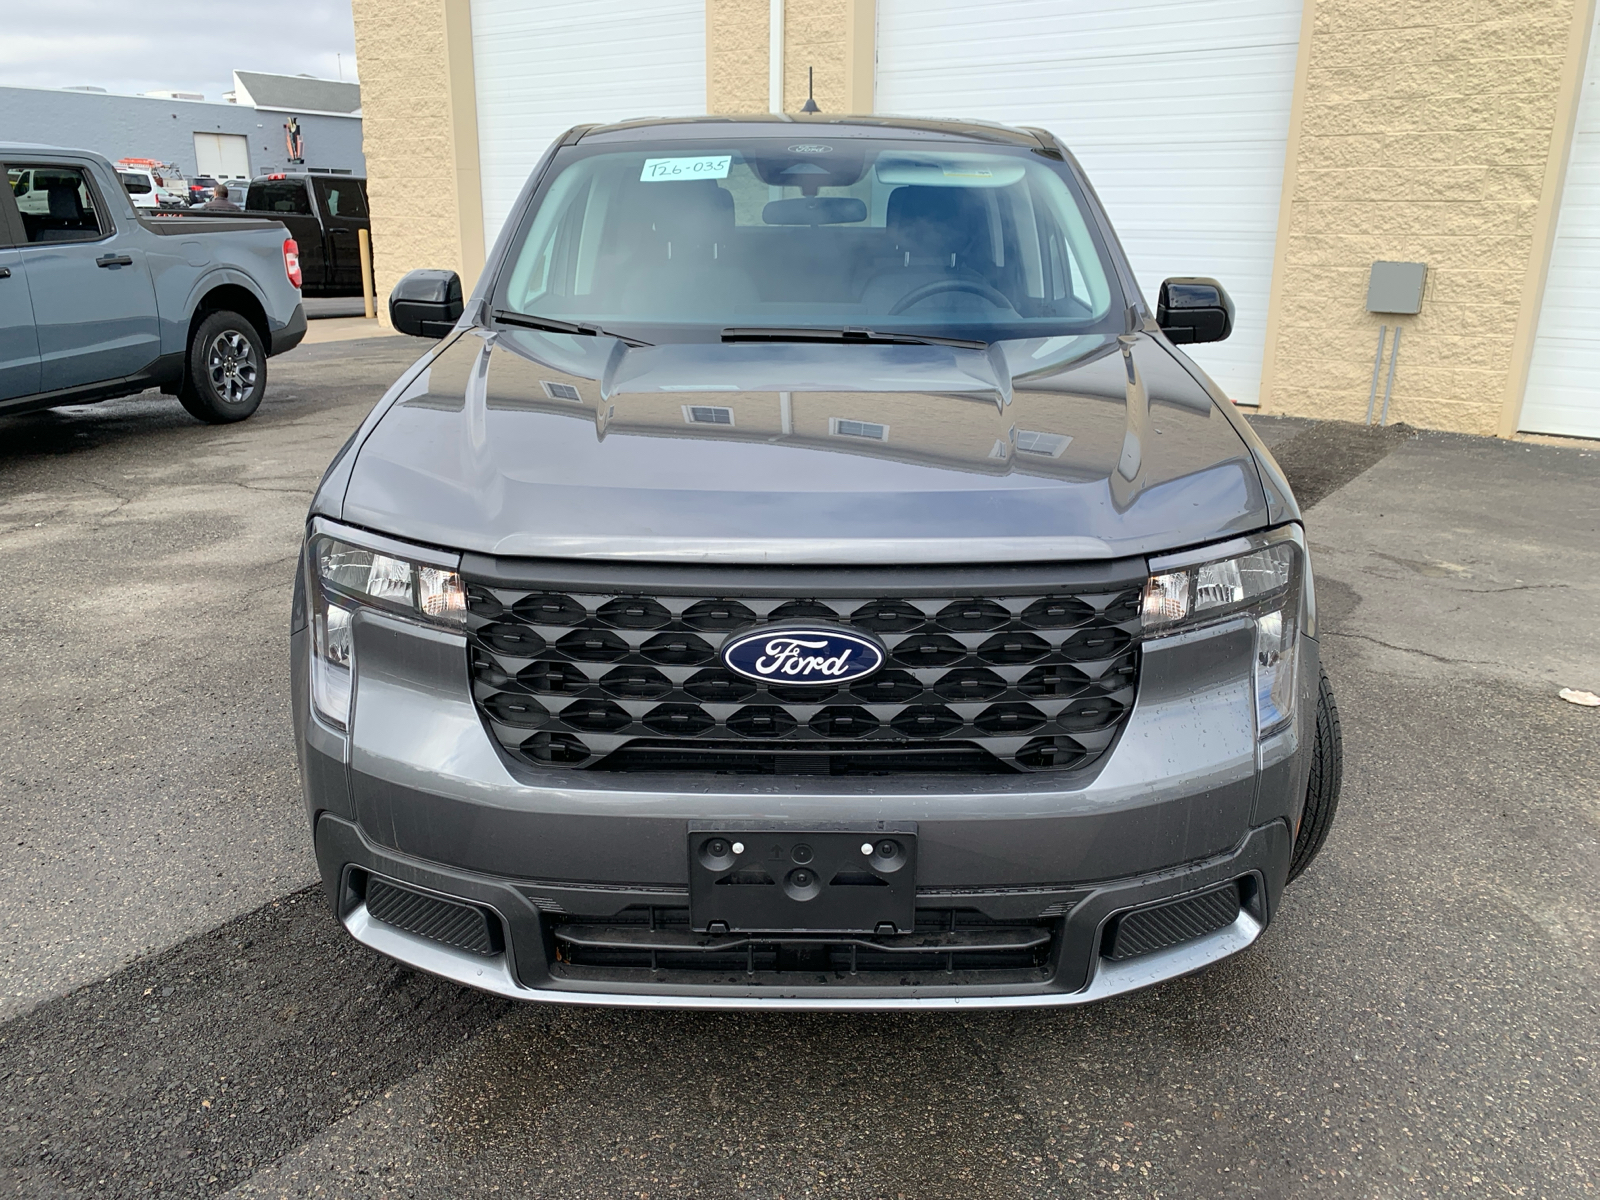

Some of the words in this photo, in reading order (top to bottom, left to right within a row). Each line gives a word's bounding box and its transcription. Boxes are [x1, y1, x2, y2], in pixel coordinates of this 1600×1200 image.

[795, 145, 825, 153] Ford
[648, 160, 728, 177] T26-035
[755, 638, 852, 675] Ford
